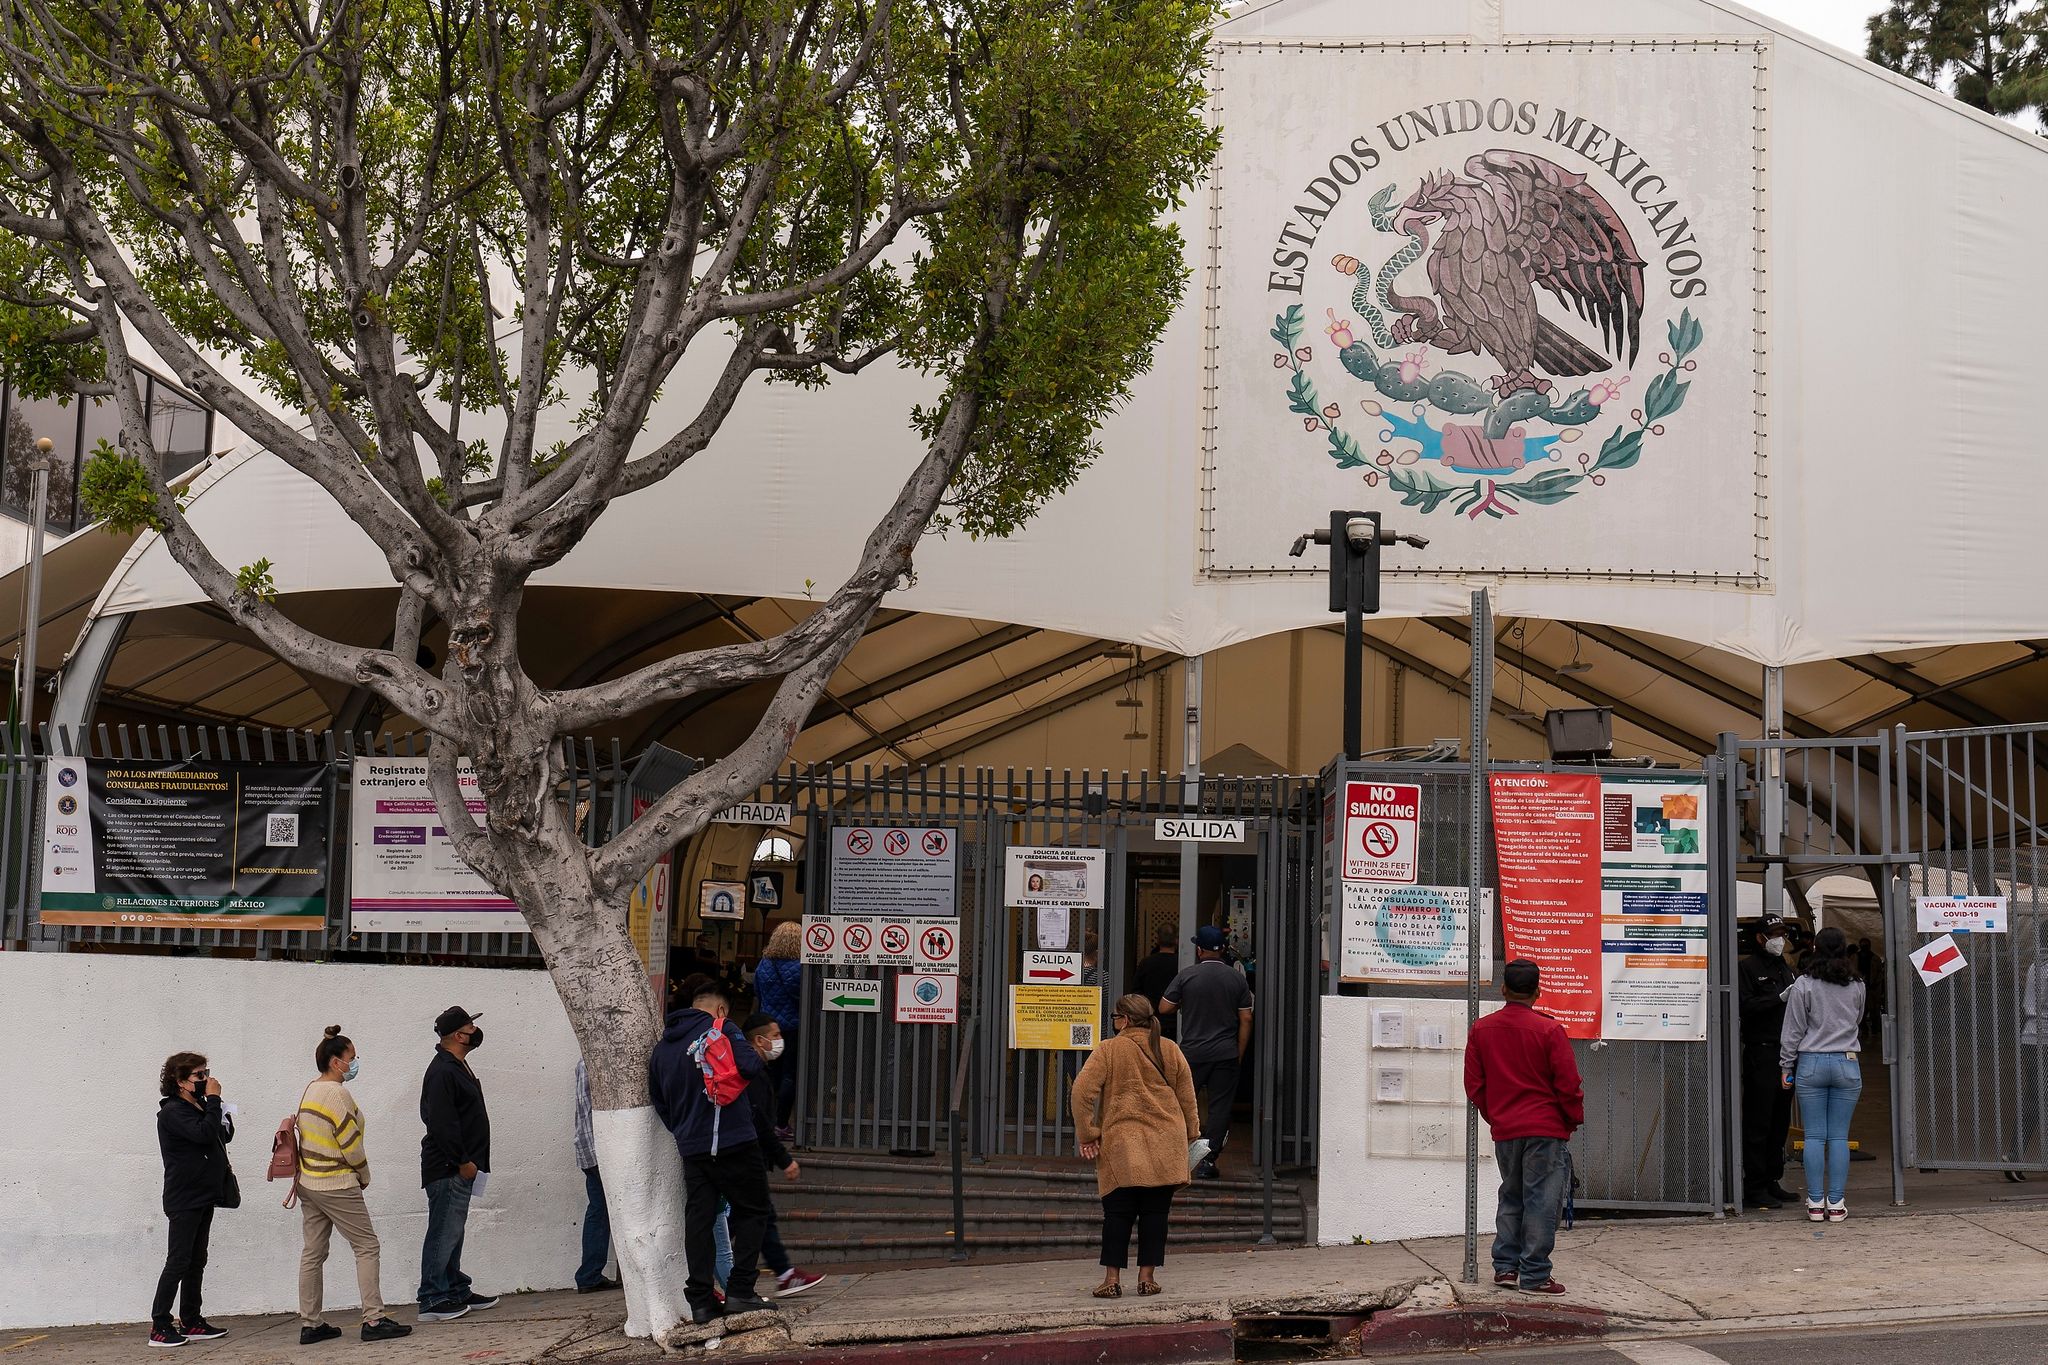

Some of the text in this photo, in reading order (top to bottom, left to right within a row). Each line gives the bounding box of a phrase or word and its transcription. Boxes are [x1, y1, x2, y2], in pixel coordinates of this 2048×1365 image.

[1268, 98, 1706, 300] ESTADOS UNIDOS MEXICANOS
[456, 766, 476, 774] vot
[148, 771, 218, 780] INTERMEDIARIOS
[106, 781, 160, 790] CONSULARES
[360, 778, 416, 787] extranjero
[1494, 777, 1548, 787] ATENCIÓN:
[1370, 787, 1395, 802] NO
[712, 805, 786, 821] NTRADA
[1350, 802, 1414, 818] SMOKING
[56, 827, 77, 835] ROJO
[1163, 821, 1237, 839] SALIDA
[1364, 869, 1405, 877] DOORWAY
[1374, 888, 1428, 896] PROGRAMAR
[169, 899, 219, 907] EXTERIORES
[230, 898, 265, 908] MÉXICO
[1032, 955, 1073, 965] SALIDA
[826, 982, 878, 992] ENTRADA
